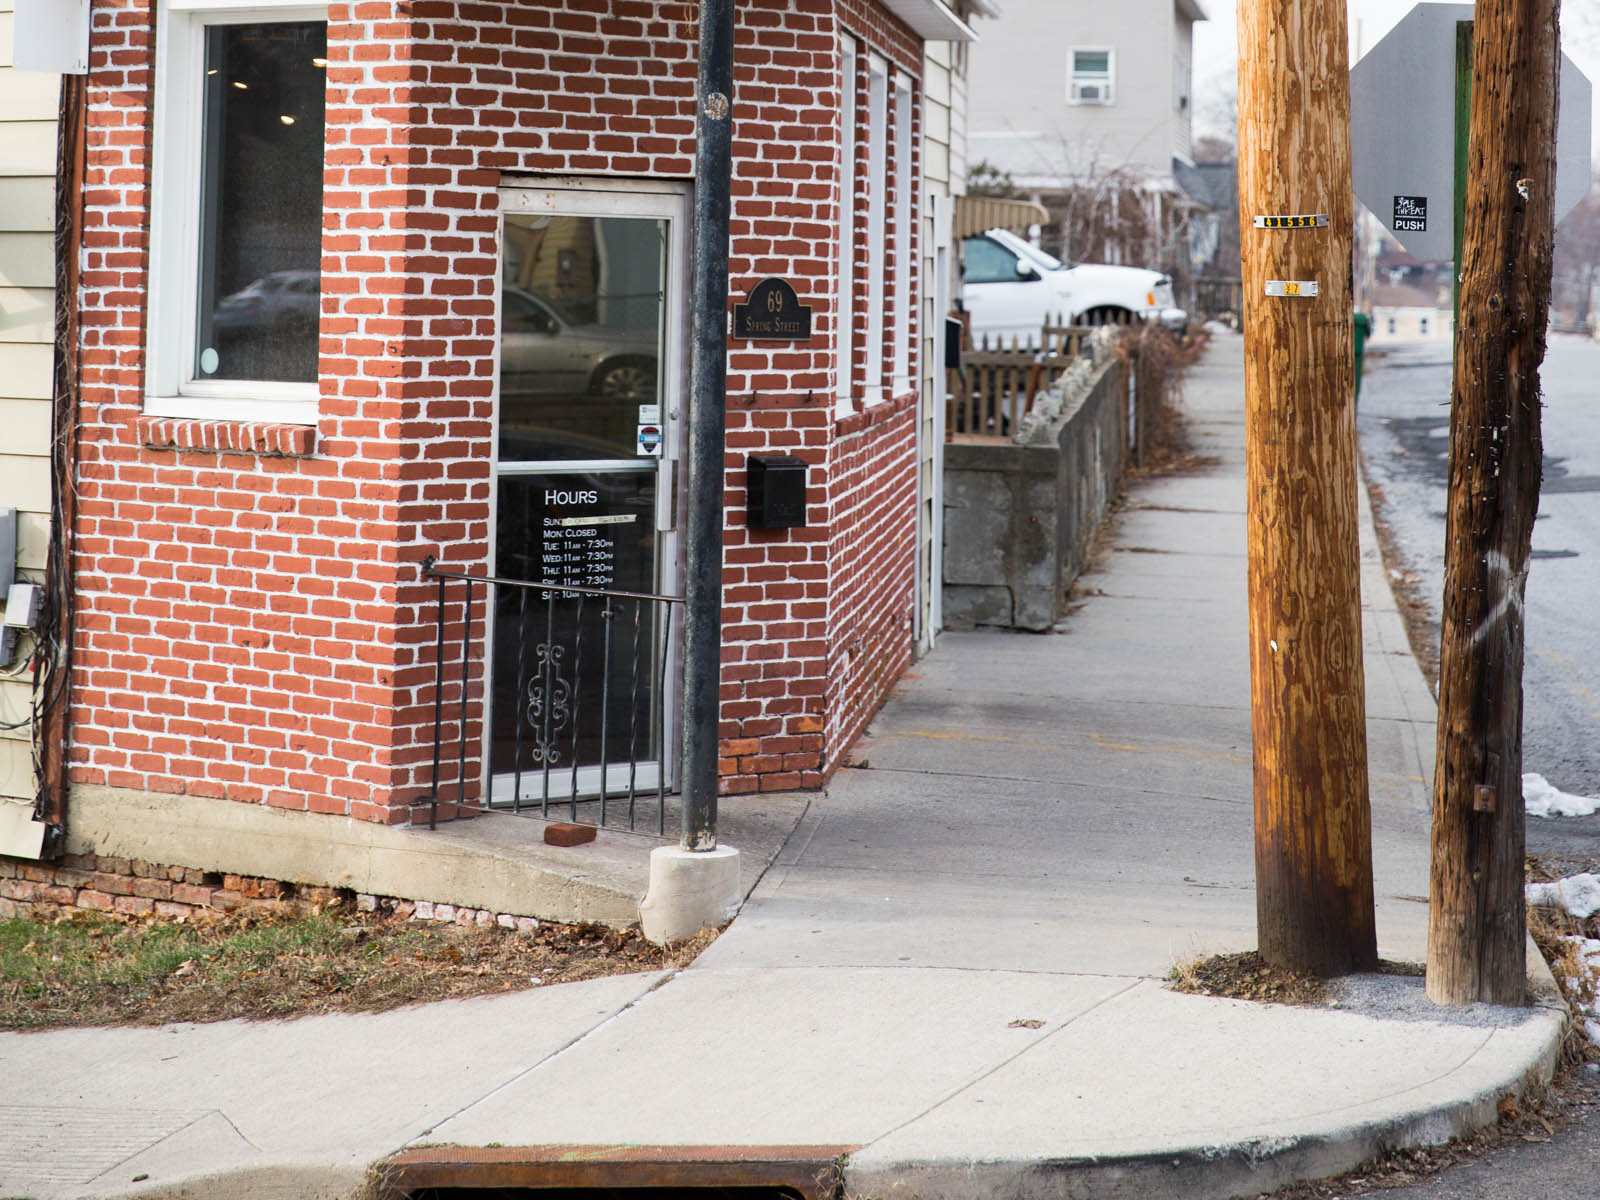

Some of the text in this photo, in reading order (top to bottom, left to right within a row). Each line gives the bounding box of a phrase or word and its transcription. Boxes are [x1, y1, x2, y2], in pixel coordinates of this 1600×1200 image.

[1266, 216, 1316, 227] 41556
[1395, 220, 1424, 230] PUSH
[767, 290, 783, 312] 69
[545, 490, 598, 505] HOURS
[565, 528, 597, 537] CLOSED
[563, 541, 580, 549] 11AM
[587, 539, 613, 548] 7:30PM
[563, 553, 580, 561] 11AM
[587, 551, 613, 560] 7:30PM
[586, 563, 613, 573] 7:30PM
[586, 576, 613, 584] 7:30PM
